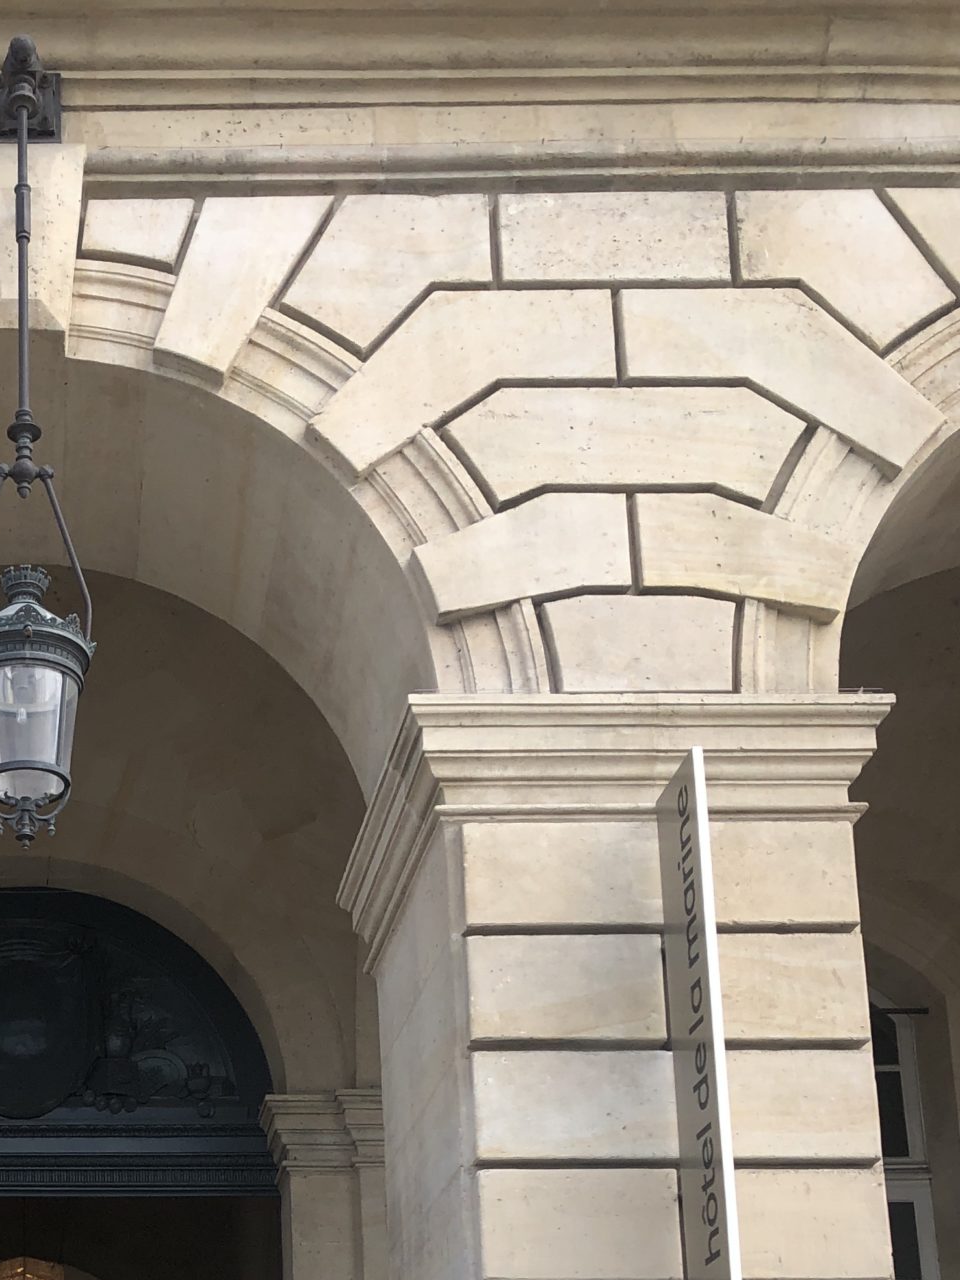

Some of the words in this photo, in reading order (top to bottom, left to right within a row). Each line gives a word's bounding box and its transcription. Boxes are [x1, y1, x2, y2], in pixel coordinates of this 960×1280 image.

[677, 784, 700, 969] marine
[689, 976, 704, 1036] la
[693, 1041, 710, 1111] de
[696, 1122, 721, 1267] hôtel
